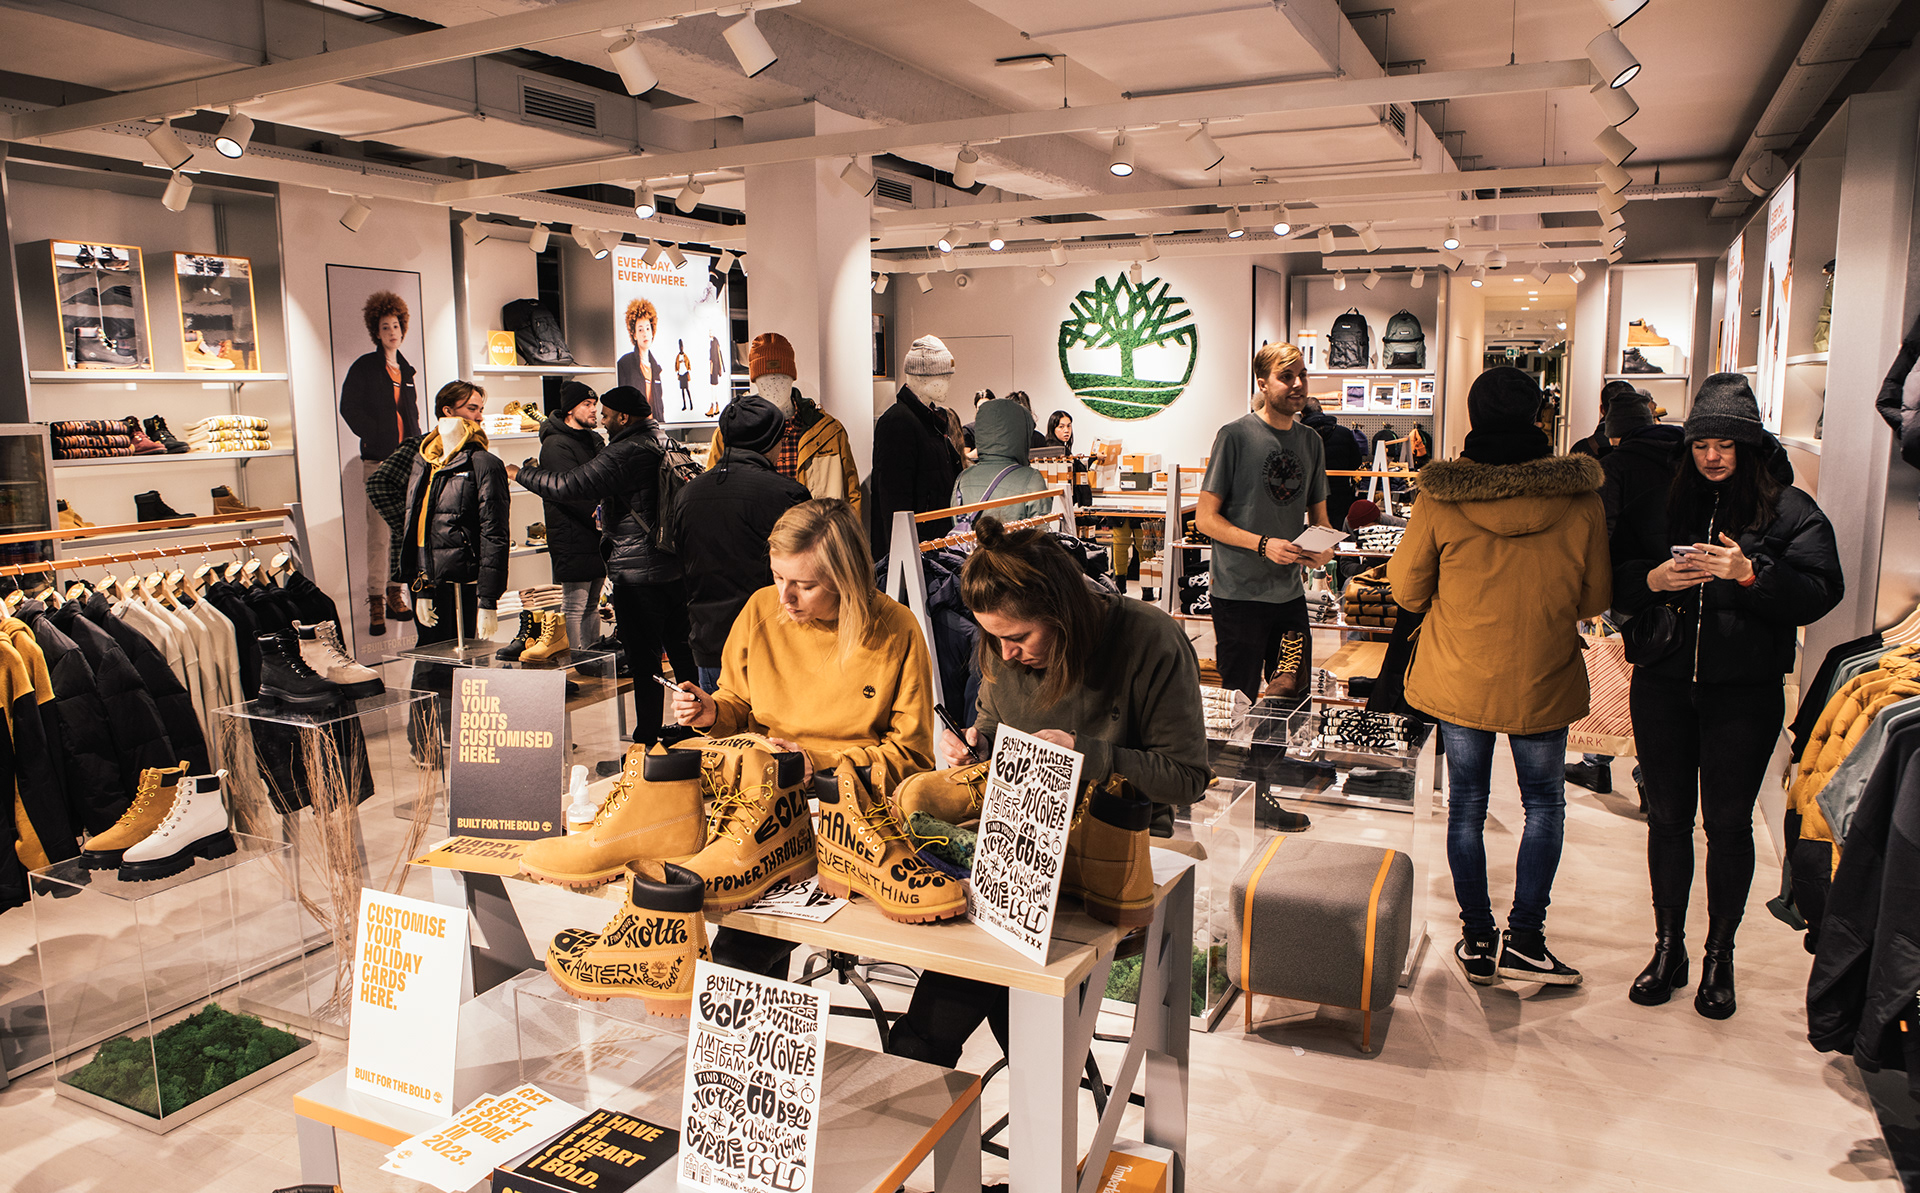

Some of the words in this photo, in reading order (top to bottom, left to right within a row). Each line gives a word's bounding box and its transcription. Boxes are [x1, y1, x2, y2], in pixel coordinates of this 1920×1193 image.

[618, 270, 688, 287] EVERYWHERE.
[461, 678, 488, 696] GET
[461, 695, 500, 713] YOUR
[460, 712, 508, 730] BOOTS
[459, 729, 554, 748] CUSTOMISED
[459, 746, 500, 764] HERE.
[1036, 748, 1075, 768] MADE
[457, 817, 480, 829] BUILT
[481, 818, 499, 830] FOR
[499, 819, 516, 830] THE
[516, 819, 540, 831] BOLD
[818, 808, 875, 863] HANGE
[452, 837, 519, 851] HAPPY
[714, 865, 763, 893] POWER
[817, 842, 920, 904] EVERYTHING
[367, 902, 446, 939] CUSTOMISE
[366, 922, 402, 949] YOUR
[1476, 941, 1490, 949] NIKE
[363, 942, 423, 975] HOLIDAY
[362, 962, 407, 992] CARDS
[706, 974, 746, 996] BUILT
[360, 982, 398, 1011] HERE.
[762, 987, 819, 1007] MADE
[354, 1067, 376, 1084] BUILT
[376, 1073, 392, 1089] FOR
[393, 1079, 409, 1094] THE
[409, 1083, 431, 1101] BOLD
[698, 1070, 719, 1084] FIND
[720, 1073, 743, 1093] YOUR
[497, 1097, 537, 1118] GET
[777, 1099, 811, 1130] BOLD
[441, 1125, 472, 1141] IN
[463, 1115, 514, 1144] DONE
[595, 1127, 611, 1138] A
[605, 1115, 664, 1143] HAVE
[421, 1134, 472, 1166] 2023.
[558, 1147, 594, 1166] OF
[573, 1136, 647, 1167] HEART
[540, 1157, 600, 1190] BOLD.
[747, 1154, 806, 1193] BOLD
